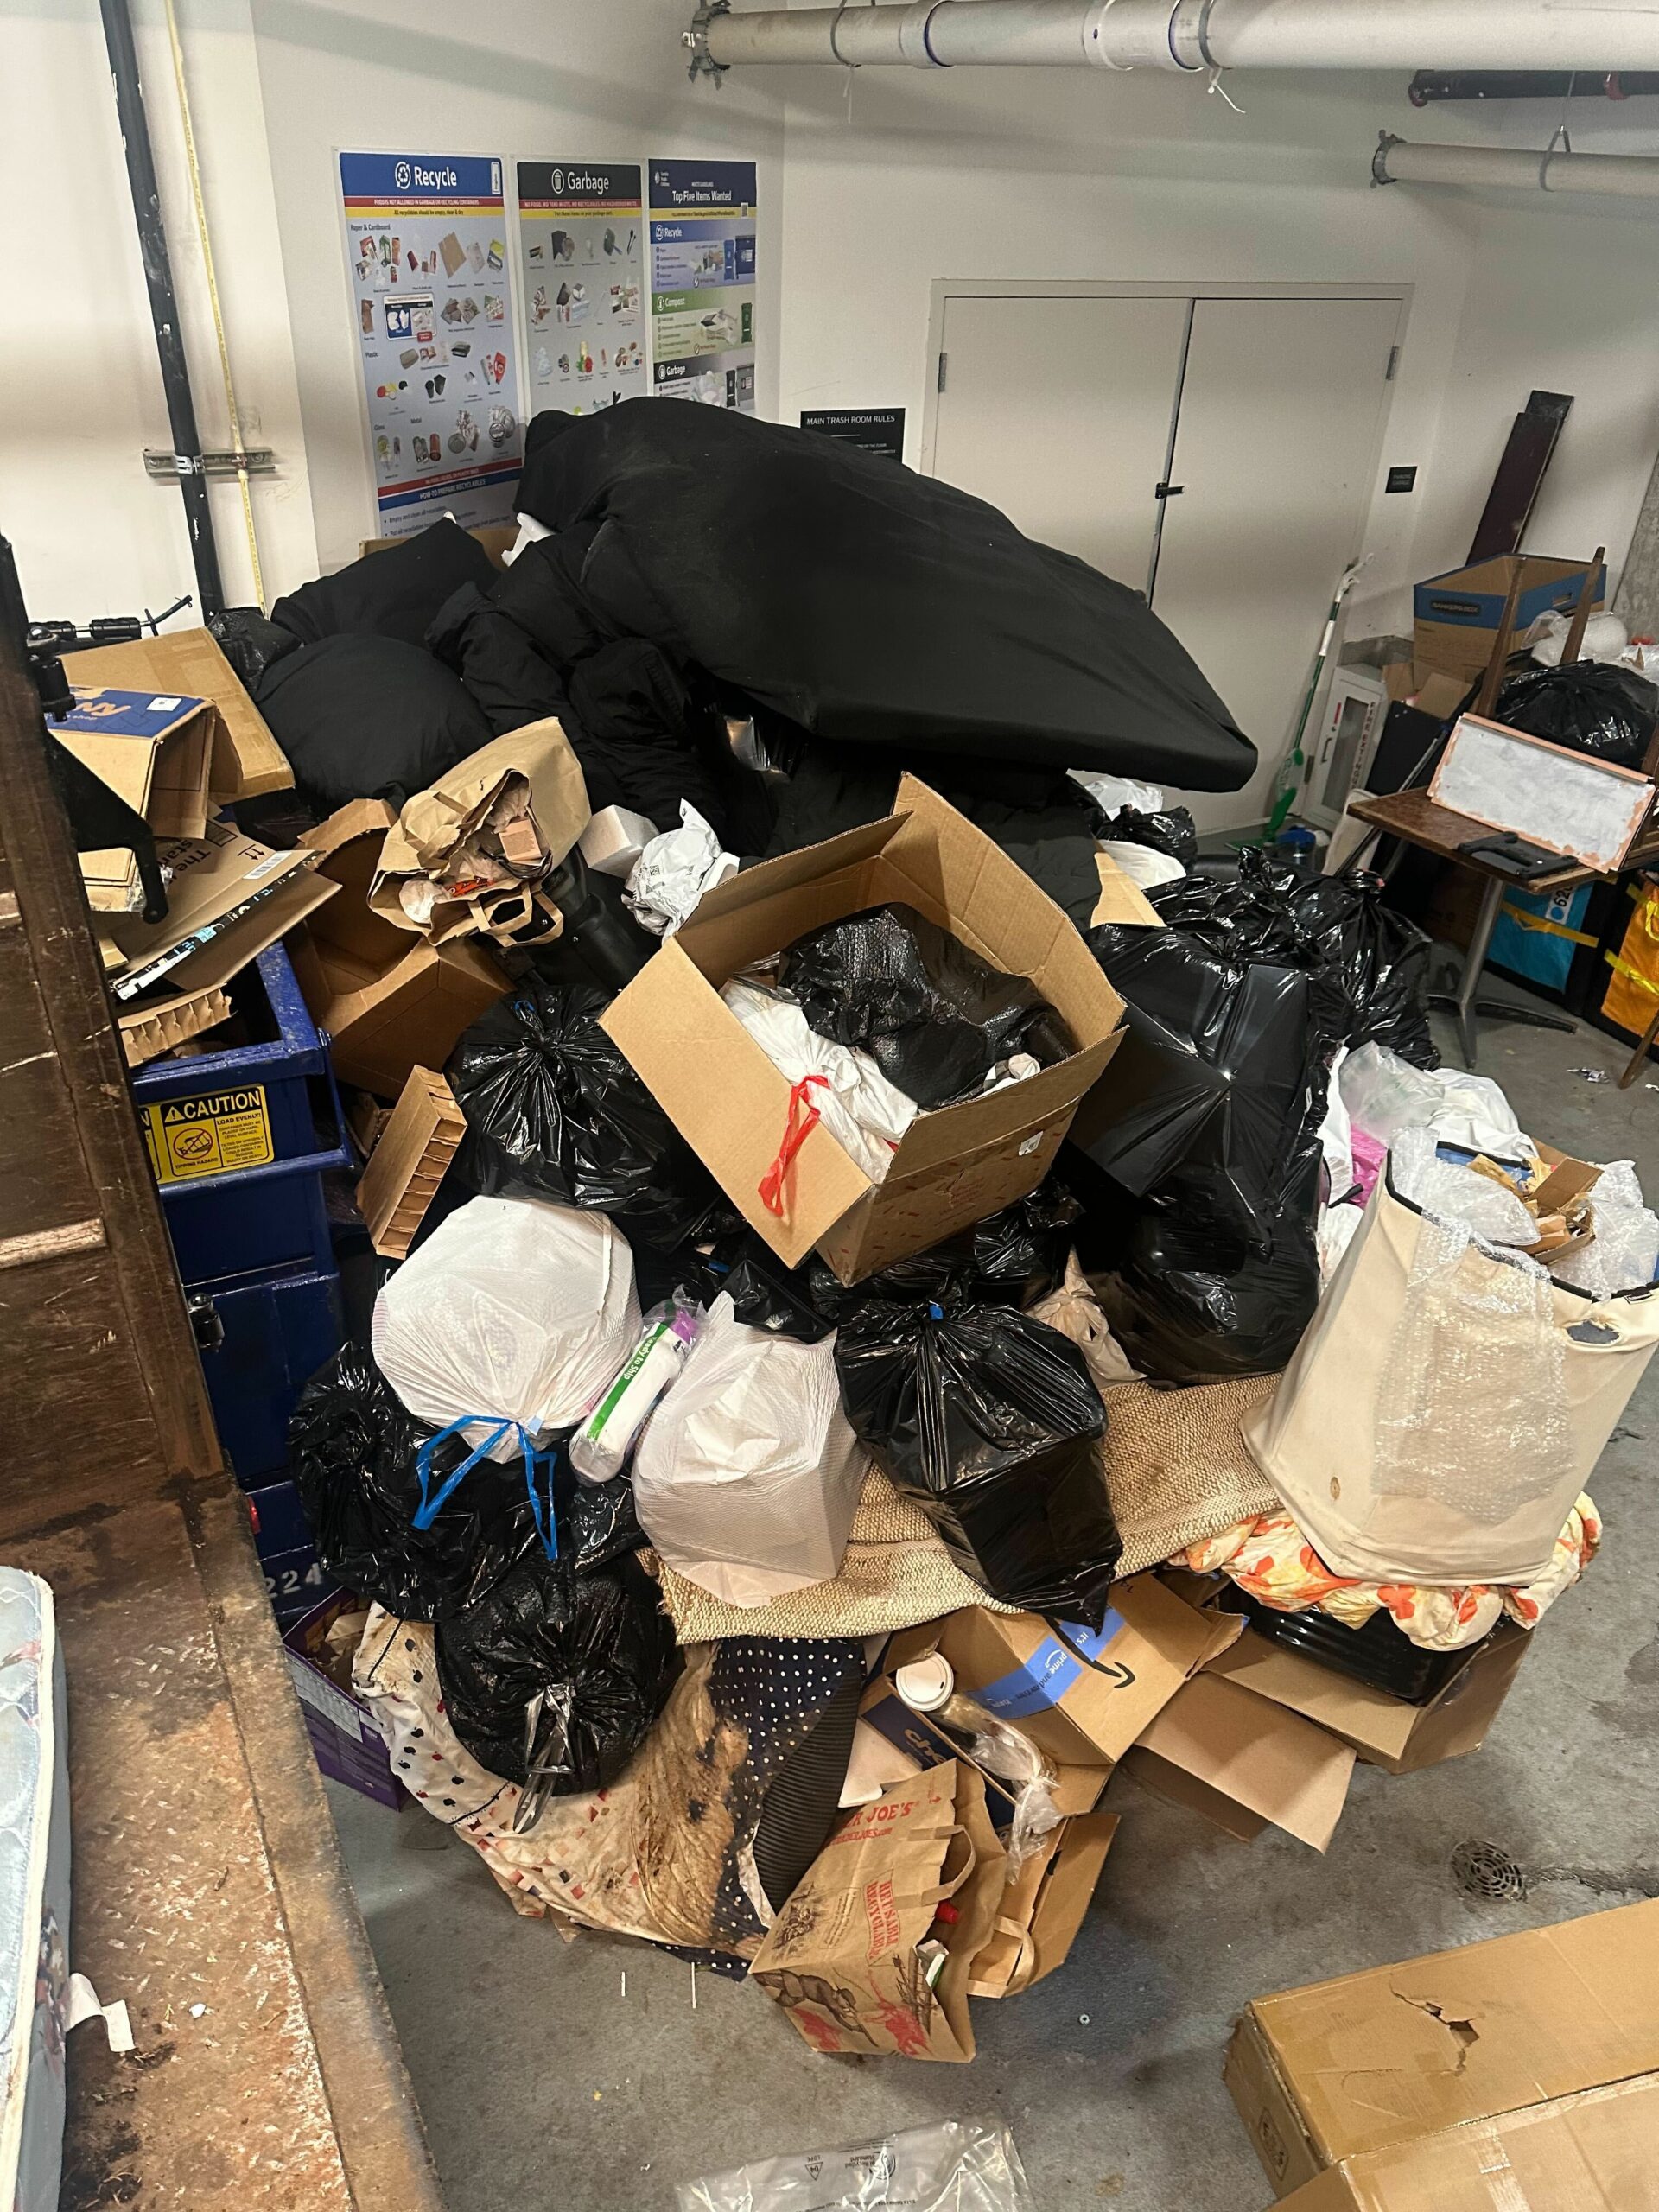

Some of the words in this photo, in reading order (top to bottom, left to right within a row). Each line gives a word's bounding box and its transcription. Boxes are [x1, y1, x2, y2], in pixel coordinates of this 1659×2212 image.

[415, 166, 457, 190] Recycle
[567, 171, 609, 195] Garbage
[672, 190, 683, 204] Top
[683, 190, 695, 201] Five
[696, 190, 710, 201] Items
[711, 190, 732, 201] Wanted
[368, 223, 391, 232] Cardboard
[664, 226, 683, 238] Recycle
[664, 297, 685, 308] Compost
[666, 365, 686, 377] Garbage
[850, 415, 872, 423] ROOM
[175, 849, 211, 871] The
[183, 1090, 261, 1118] CAUTION
[633, 1357, 643, 1365] to
[623, 1363, 639, 1381] Ship
[1077, 1631, 1089, 1645] It's
[1049, 1650, 1068, 1675] prime
[1037, 1672, 1051, 1688] and
[866, 1801, 914, 1823] JOE'S
[880, 1880, 899, 1946] REUSABLE
